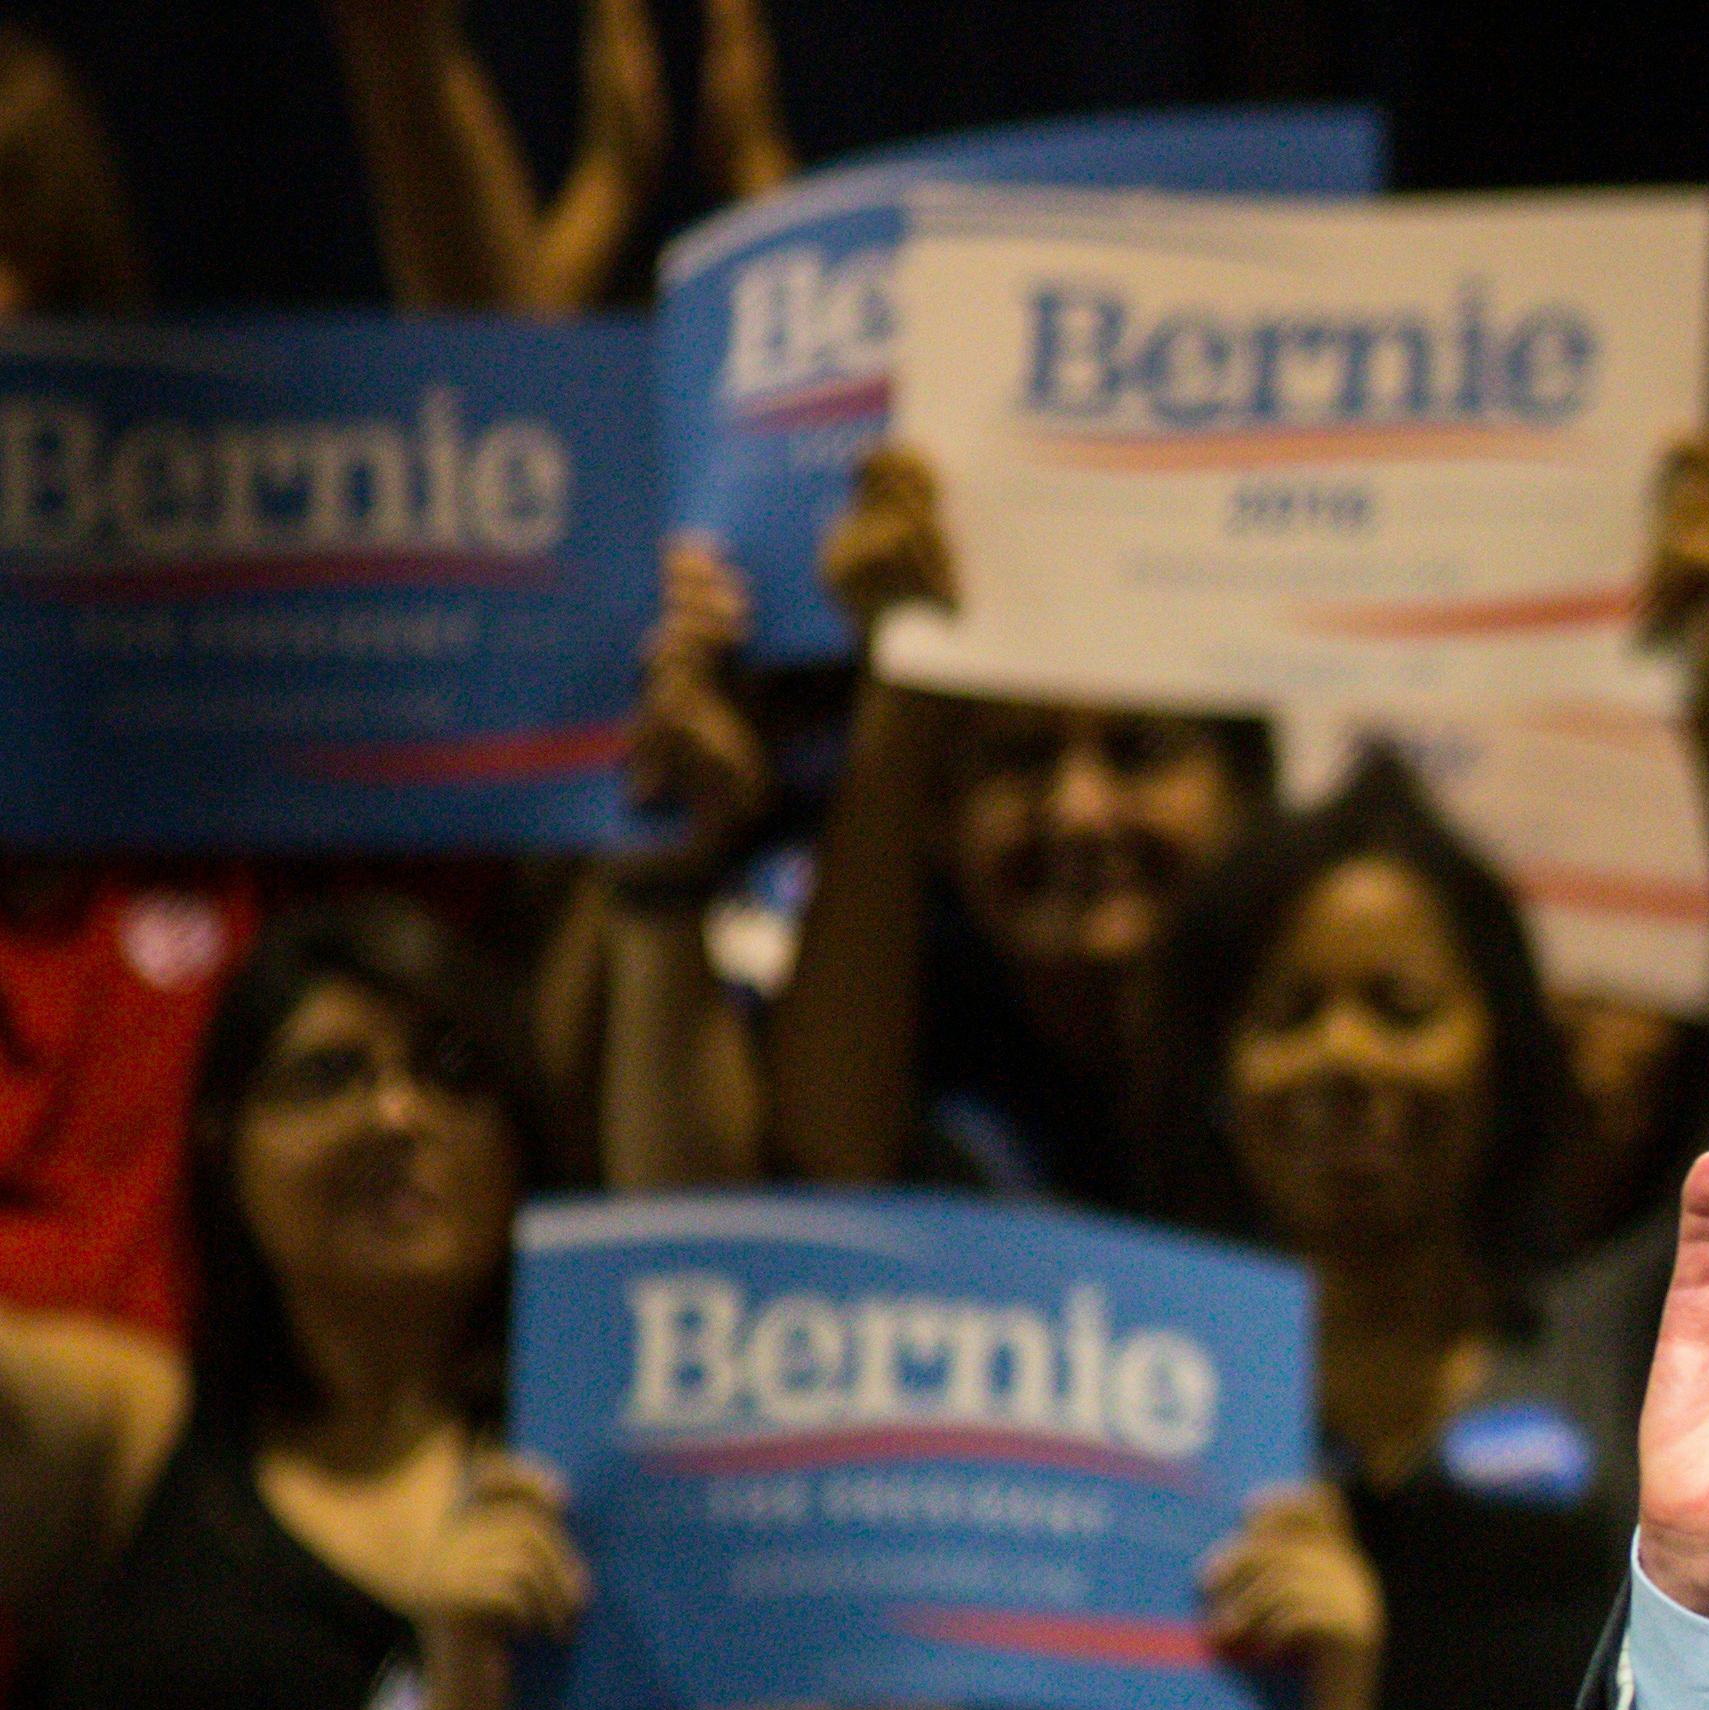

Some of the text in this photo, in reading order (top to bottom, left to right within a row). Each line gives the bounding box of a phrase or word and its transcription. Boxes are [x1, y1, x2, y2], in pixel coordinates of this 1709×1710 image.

[1019, 277, 1598, 426] Bernie
[0, 384, 569, 553] Bernie
[625, 1274, 1220, 1458] Bernie
